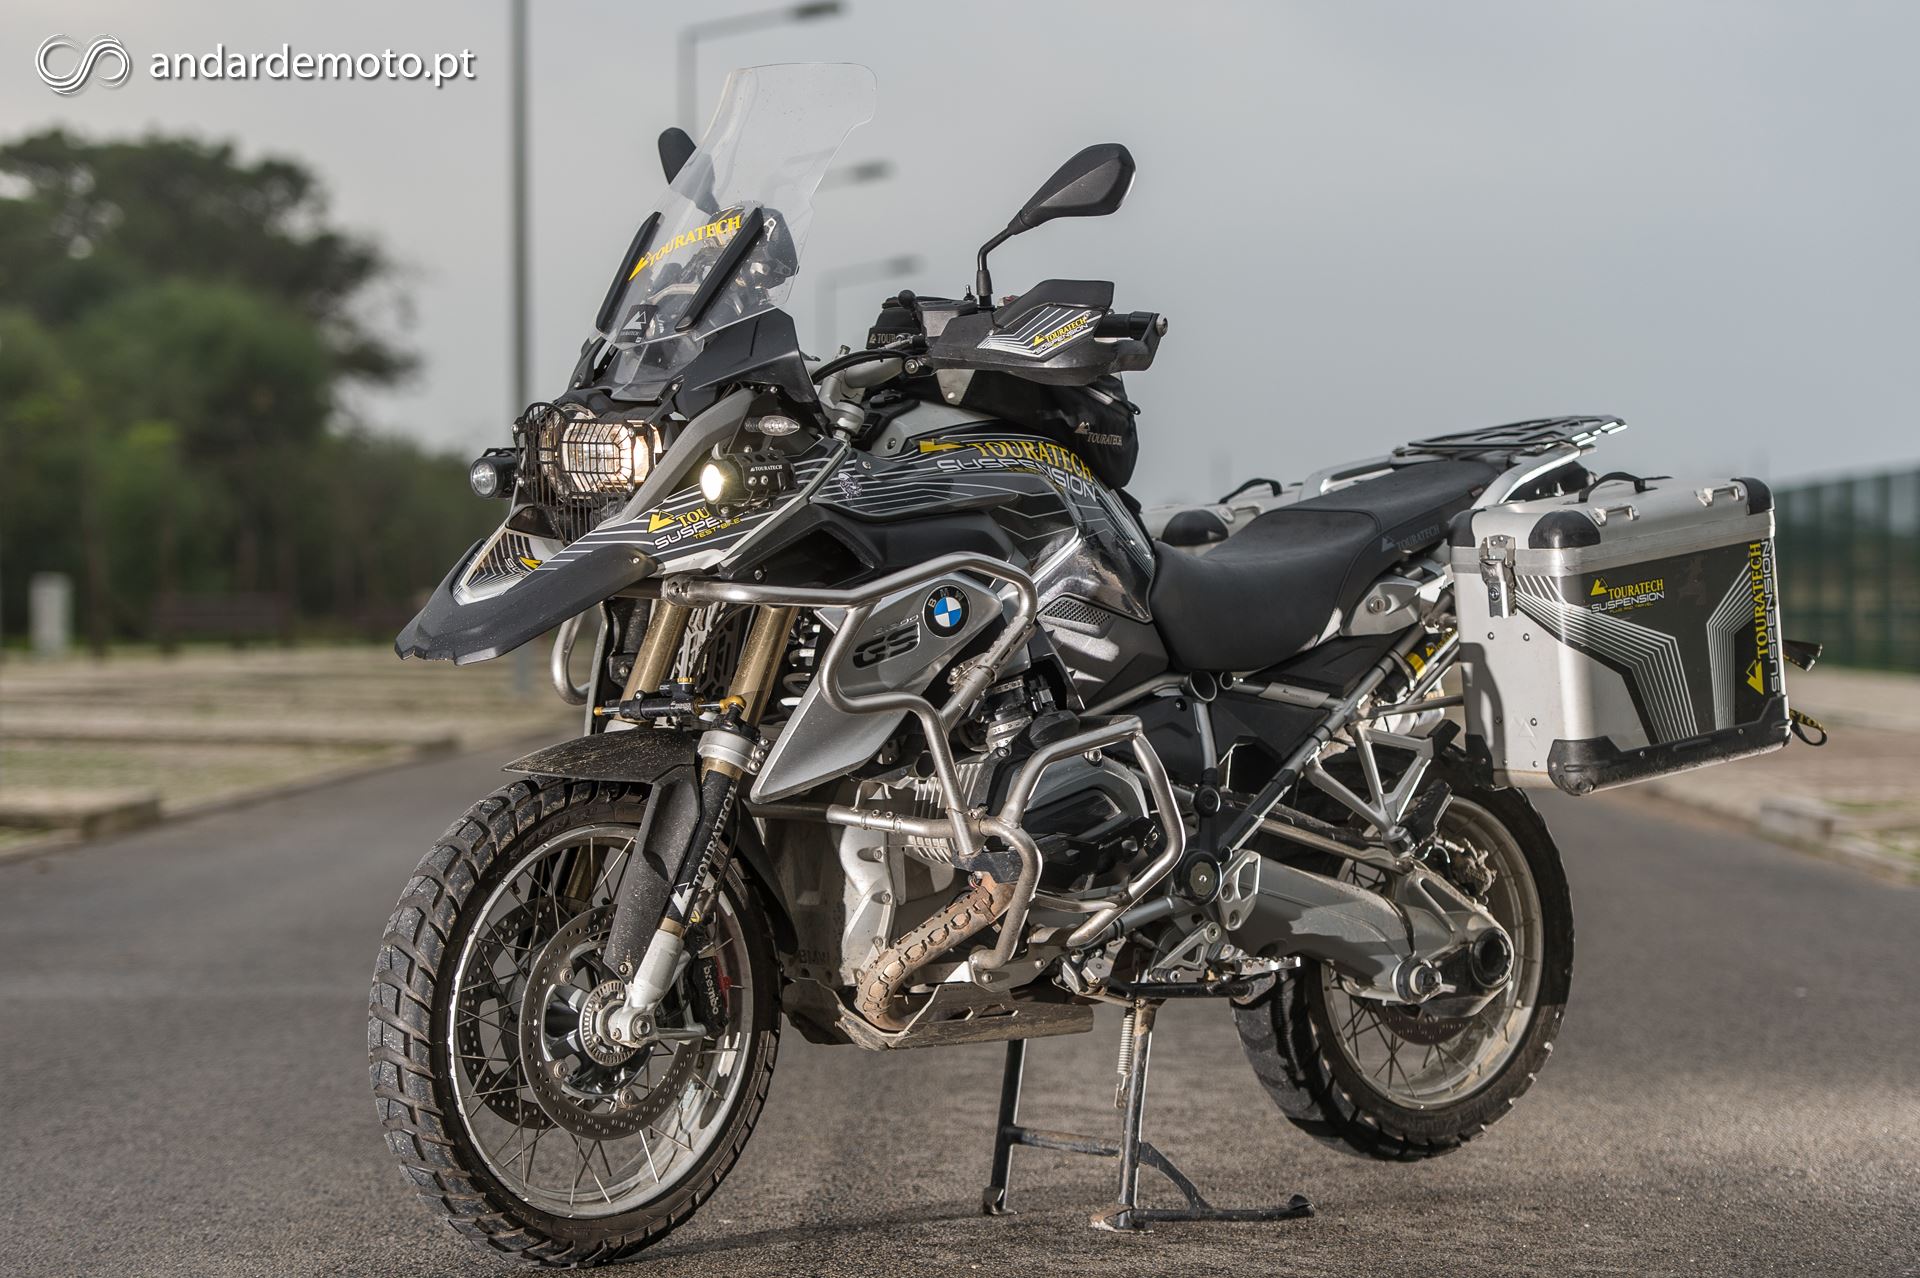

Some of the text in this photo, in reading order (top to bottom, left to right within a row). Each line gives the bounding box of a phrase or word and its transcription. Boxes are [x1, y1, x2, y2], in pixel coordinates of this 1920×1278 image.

[649, 214, 742, 267] TOURATECH
[1046, 317, 1087, 342] TOURATECH
[1087, 431, 1123, 446] TOURATECH
[936, 458, 1098, 503] SUSPENSION
[966, 440, 1094, 483] TOURATECH
[654, 516, 722, 550] SUSPE
[693, 526, 717, 540] TEST
[1396, 524, 1441, 551] TOURATECH
[927, 587, 965, 609] BMW
[1591, 591, 1665, 613] SUSPENSION
[1608, 578, 1665, 600] TOURATECH
[1750, 542, 1769, 660] TOURATECH
[1761, 540, 1781, 693] SUSPENSION
[853, 622, 920, 669] GS
[692, 783, 738, 887] TOURATECH
[703, 965, 719, 1015] brembo
